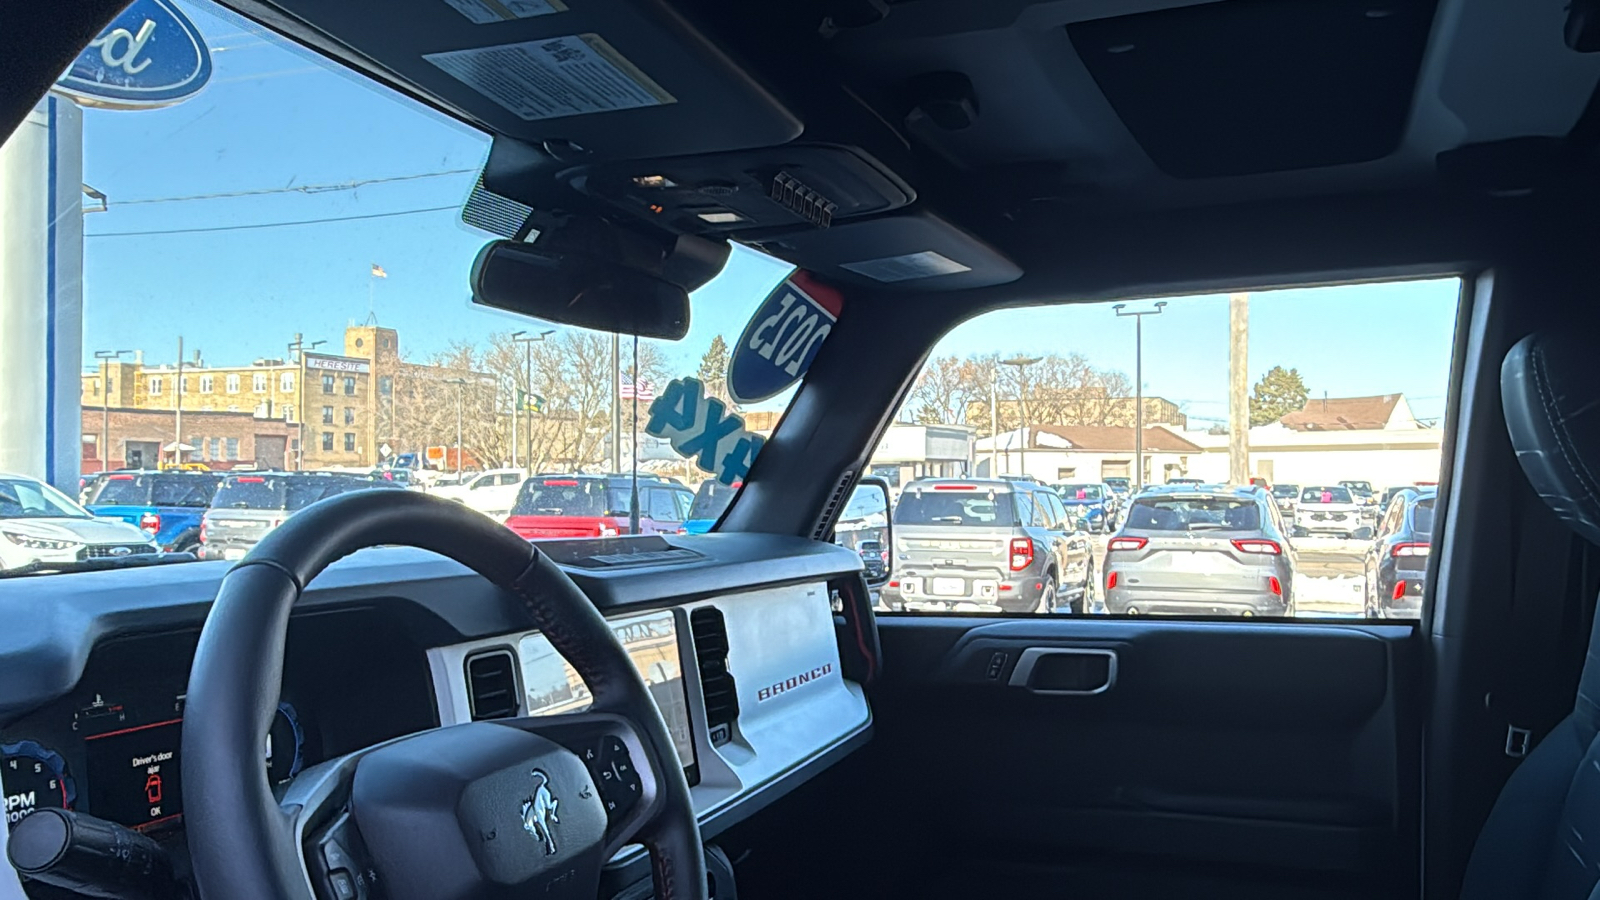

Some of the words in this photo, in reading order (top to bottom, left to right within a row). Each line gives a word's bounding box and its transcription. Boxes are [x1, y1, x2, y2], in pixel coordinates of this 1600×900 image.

[313, 360, 361, 371] HERESITE
[757, 663, 832, 702] BRONCO
[9, 760, 17, 770] 4
[132, 755, 157, 767] Driver's
[157, 752, 173, 761] door
[34, 763, 42, 773] 5
[49, 779, 57, 789] 6
[150, 806, 162, 817] OK
